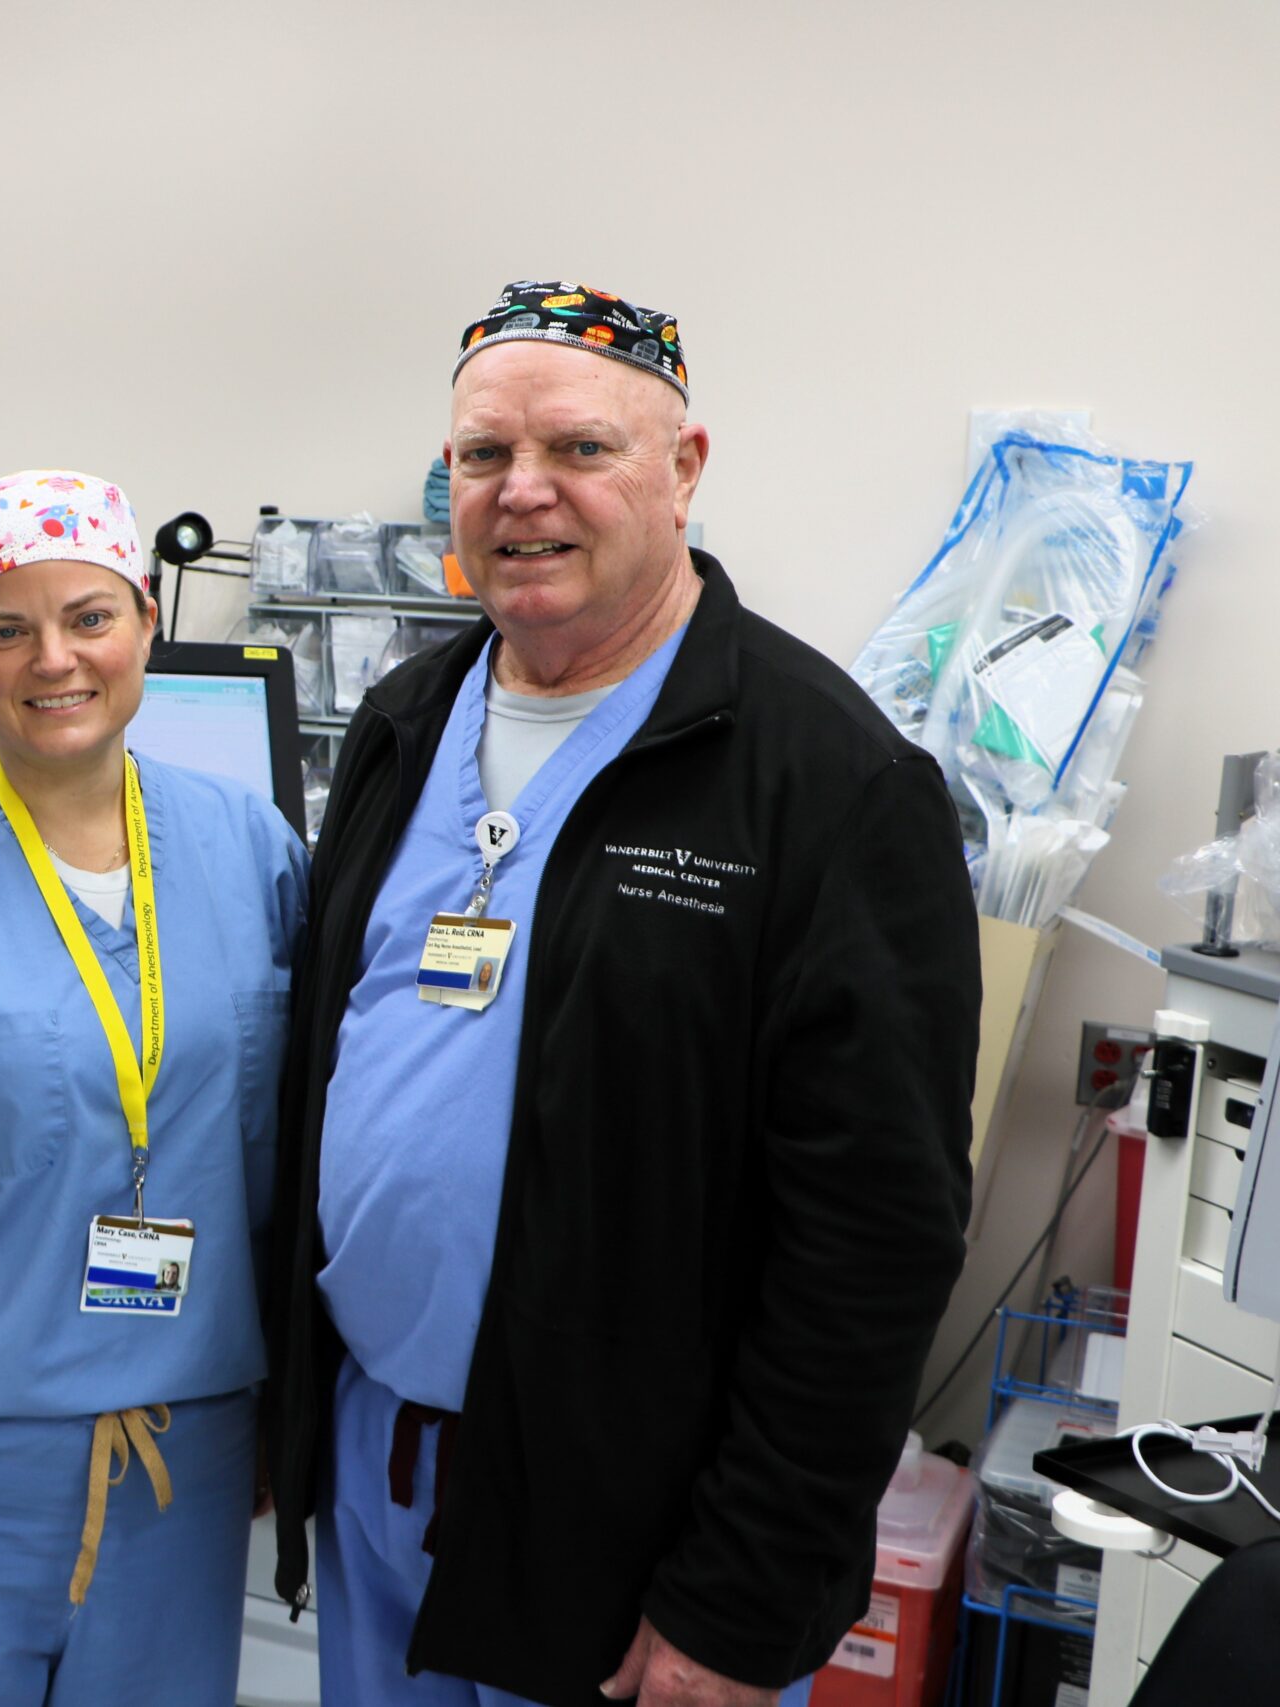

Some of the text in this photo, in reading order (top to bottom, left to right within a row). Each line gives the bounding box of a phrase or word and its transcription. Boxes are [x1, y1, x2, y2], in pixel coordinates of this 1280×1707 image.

[132, 819, 147, 878] Department
[605, 844, 673, 861] VANDERBILT
[693, 856, 757, 876] UNIVERSITY
[632, 864, 721, 888] MEDICAL CENTER
[618, 883, 725, 915] Nurse Anesthesia
[142, 902, 157, 981] Anesthesiology
[430, 926, 445, 935] Brian
[466, 929, 485, 938] CRNA
[147, 998, 161, 1067] Department
[96, 1226, 115, 1237] Mary
[118, 1228, 137, 1239] Case,
[138, 1231, 161, 1241] CRNA
